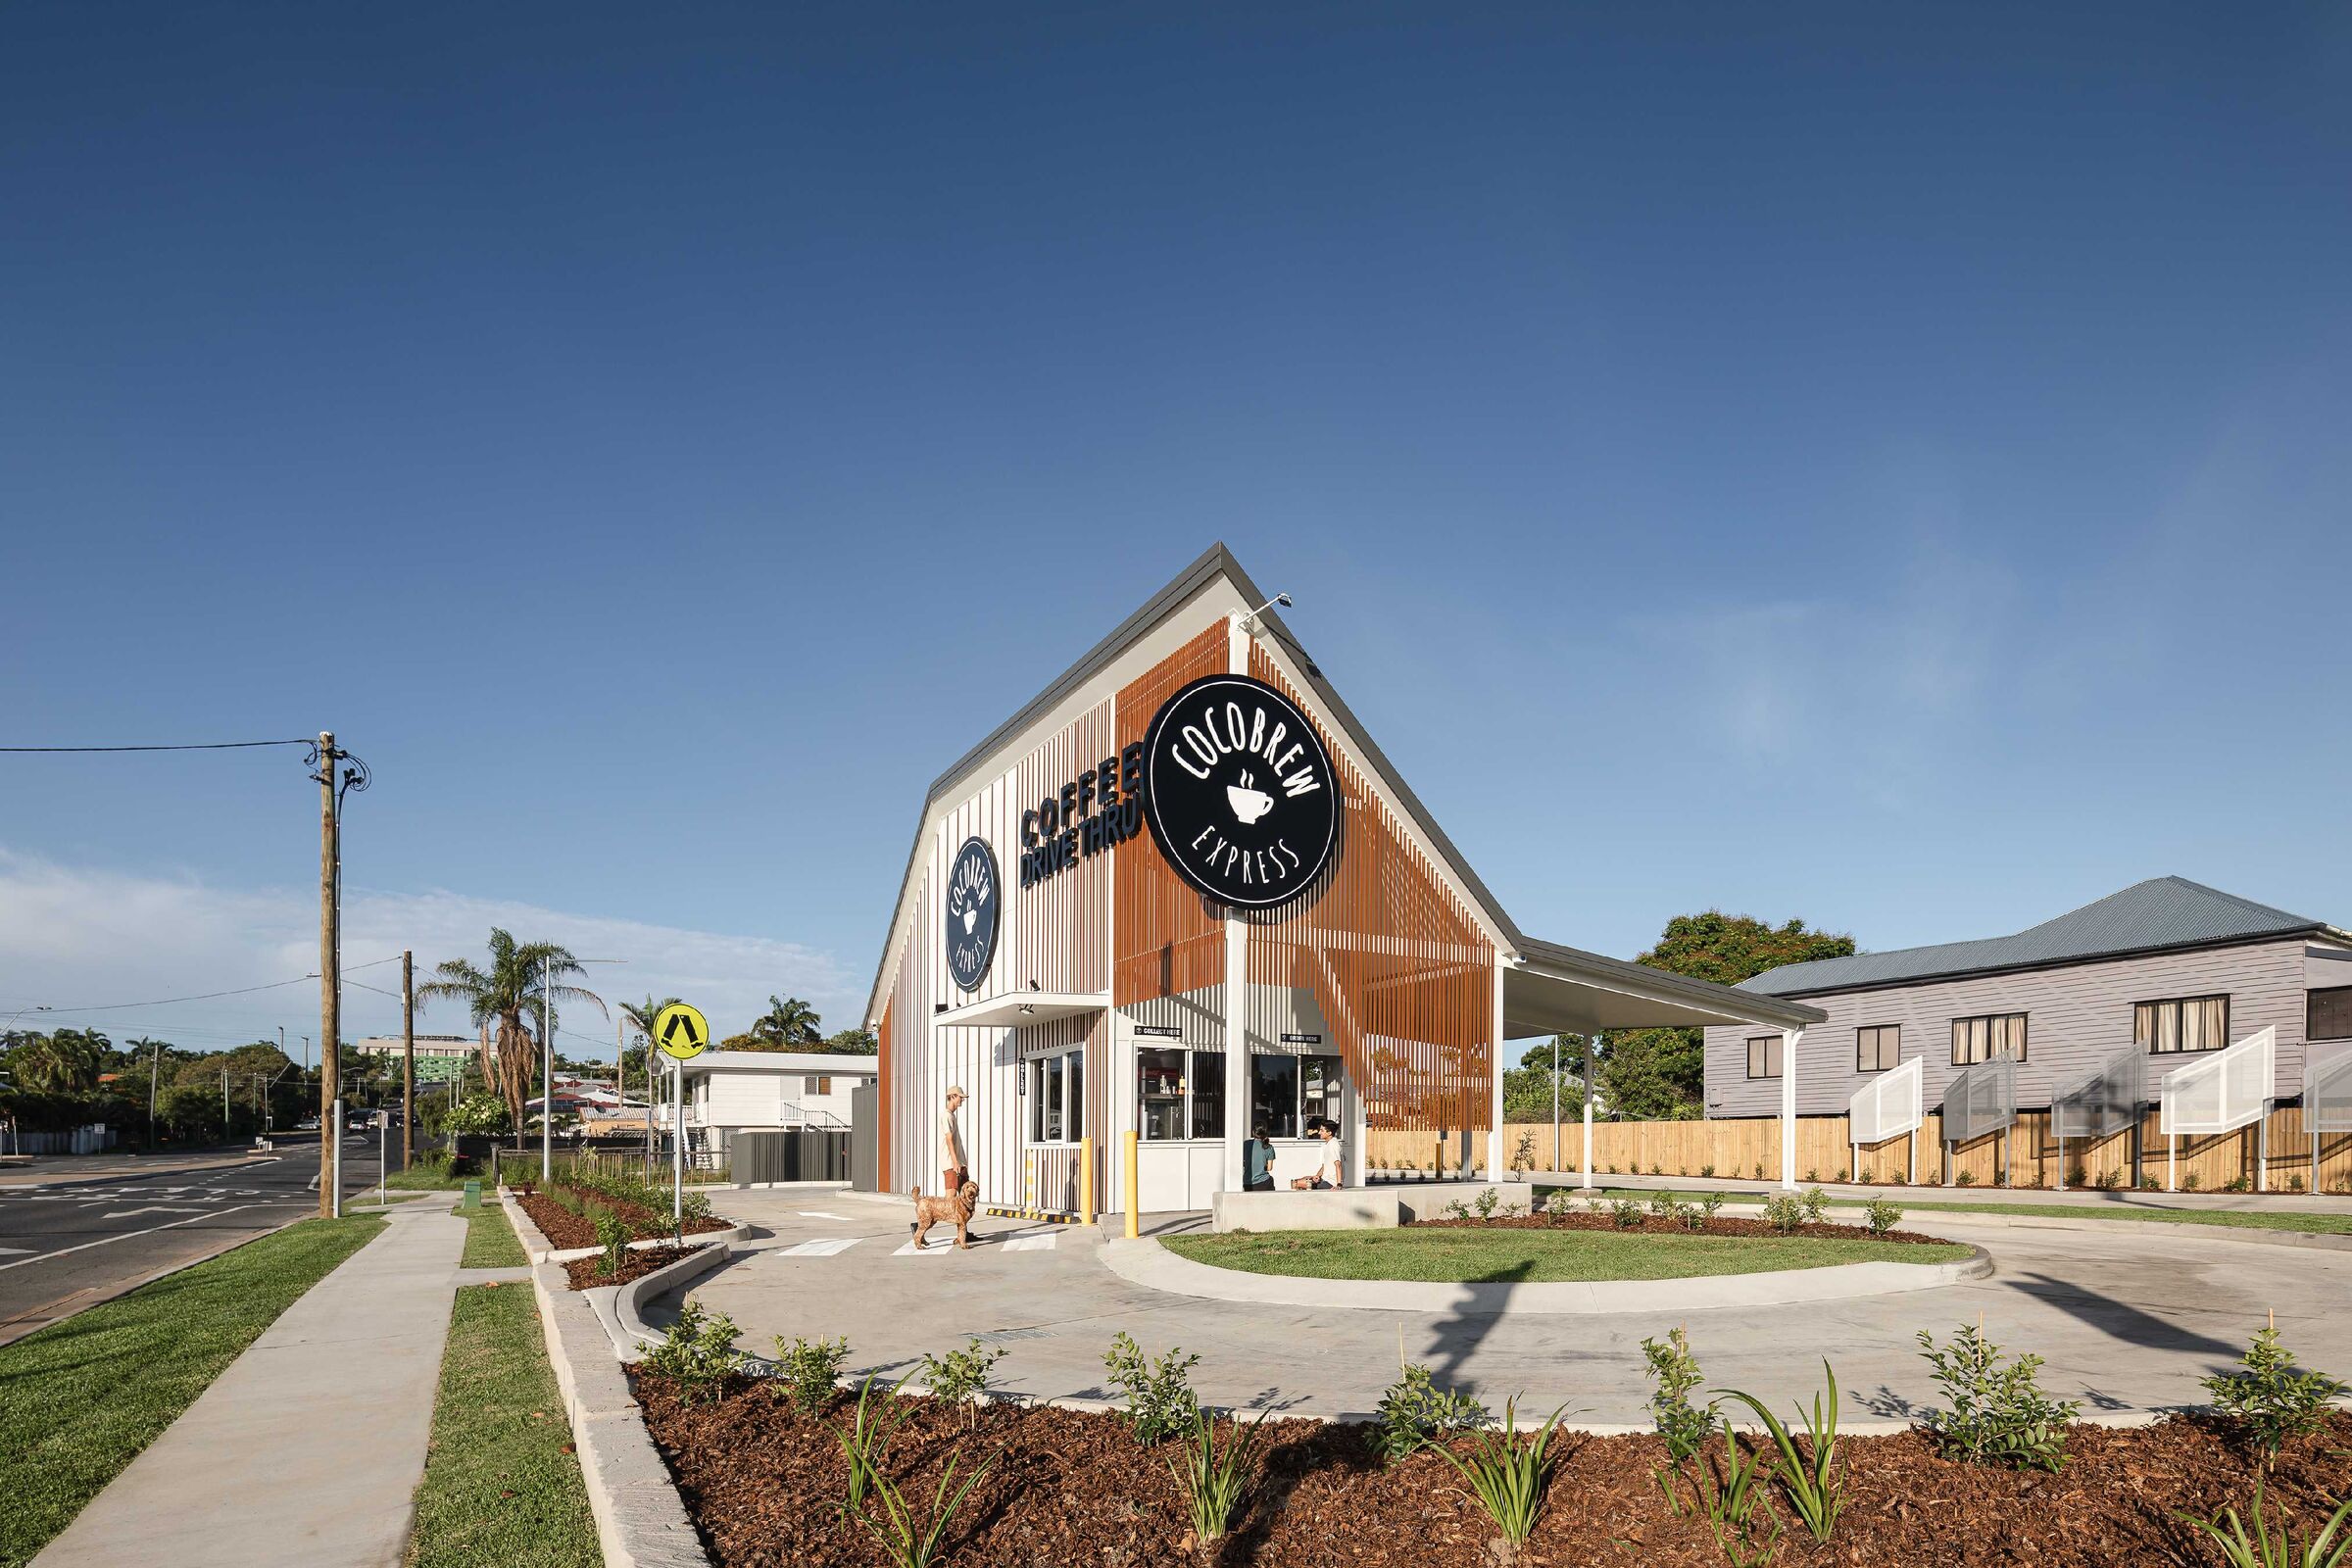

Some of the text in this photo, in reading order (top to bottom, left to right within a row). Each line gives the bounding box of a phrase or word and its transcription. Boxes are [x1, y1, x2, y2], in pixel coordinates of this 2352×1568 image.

[1021, 742, 1143, 848] COFFEE
[1172, 702, 1321, 798] COCOBREW
[951, 854, 990, 916] COCOBREW
[1020, 794, 1142, 889] DRIVE THRU
[1192, 825, 1299, 884] EXPRESS
